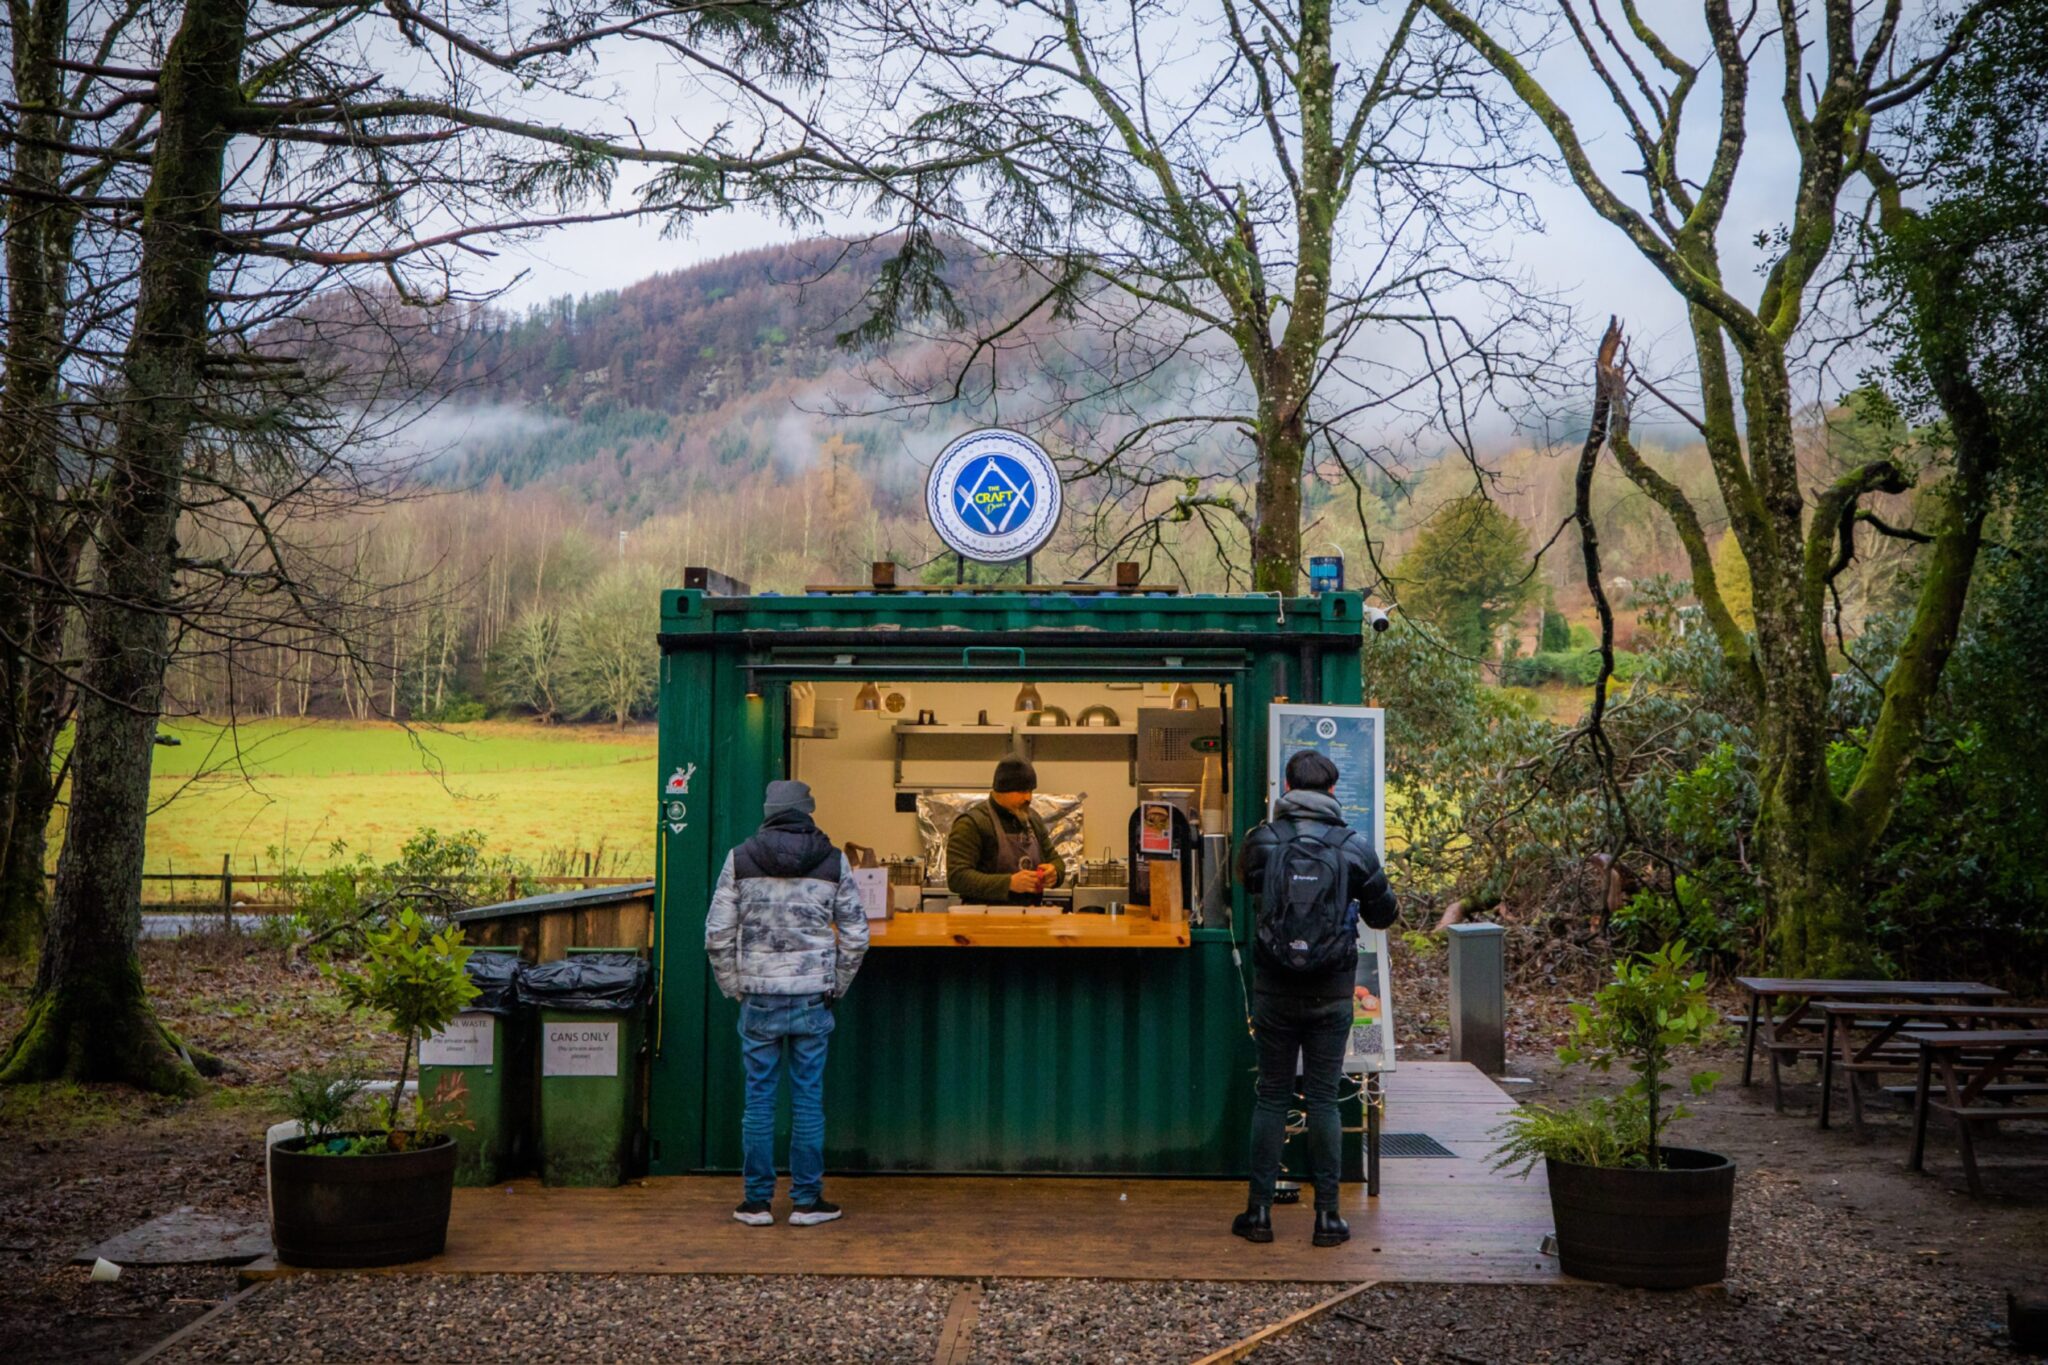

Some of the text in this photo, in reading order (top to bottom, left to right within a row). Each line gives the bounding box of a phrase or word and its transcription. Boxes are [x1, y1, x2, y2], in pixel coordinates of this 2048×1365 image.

[975, 490, 1013, 504] CRAFT
[550, 1031, 610, 1042] CANS ONLY
